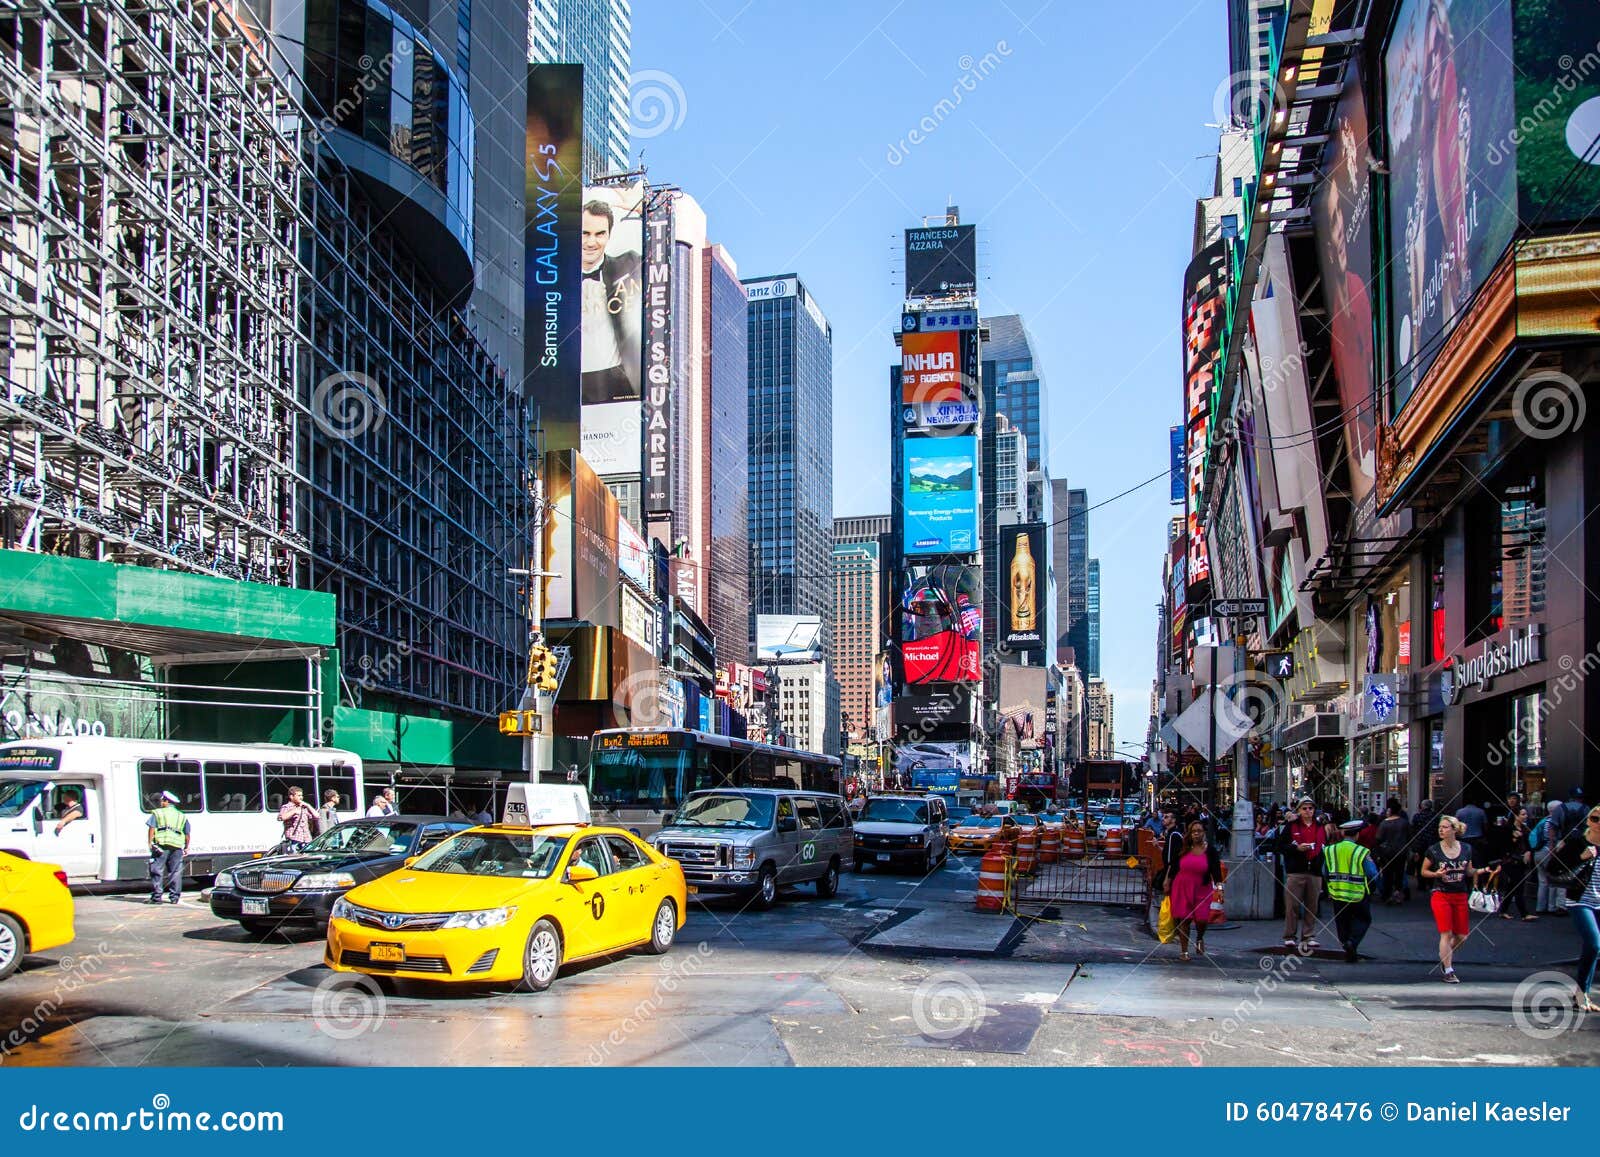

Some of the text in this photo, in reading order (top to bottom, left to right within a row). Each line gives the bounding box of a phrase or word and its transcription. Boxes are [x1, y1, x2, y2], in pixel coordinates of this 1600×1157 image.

[1457, 190, 1479, 257] hut
[536, 187, 559, 284] GALAXY
[909, 230, 959, 241] FRANCESCA
[909, 240, 943, 250] AZZARA
[541, 290, 561, 367] Samsung
[649, 220, 669, 477] TIMES SQUARE
[920, 372, 955, 384] AGENCY
[936, 404, 978, 416] XINHUA
[926, 415, 950, 424] NEWS
[1220, 604, 1261, 613] ONE WAY
[904, 652, 939, 661] Michael
[1458, 641, 1508, 693] sunglass
[1510, 624, 1538, 670] hut
[508, 803, 526, 812] 2L15
[802, 843, 815, 860] GO
